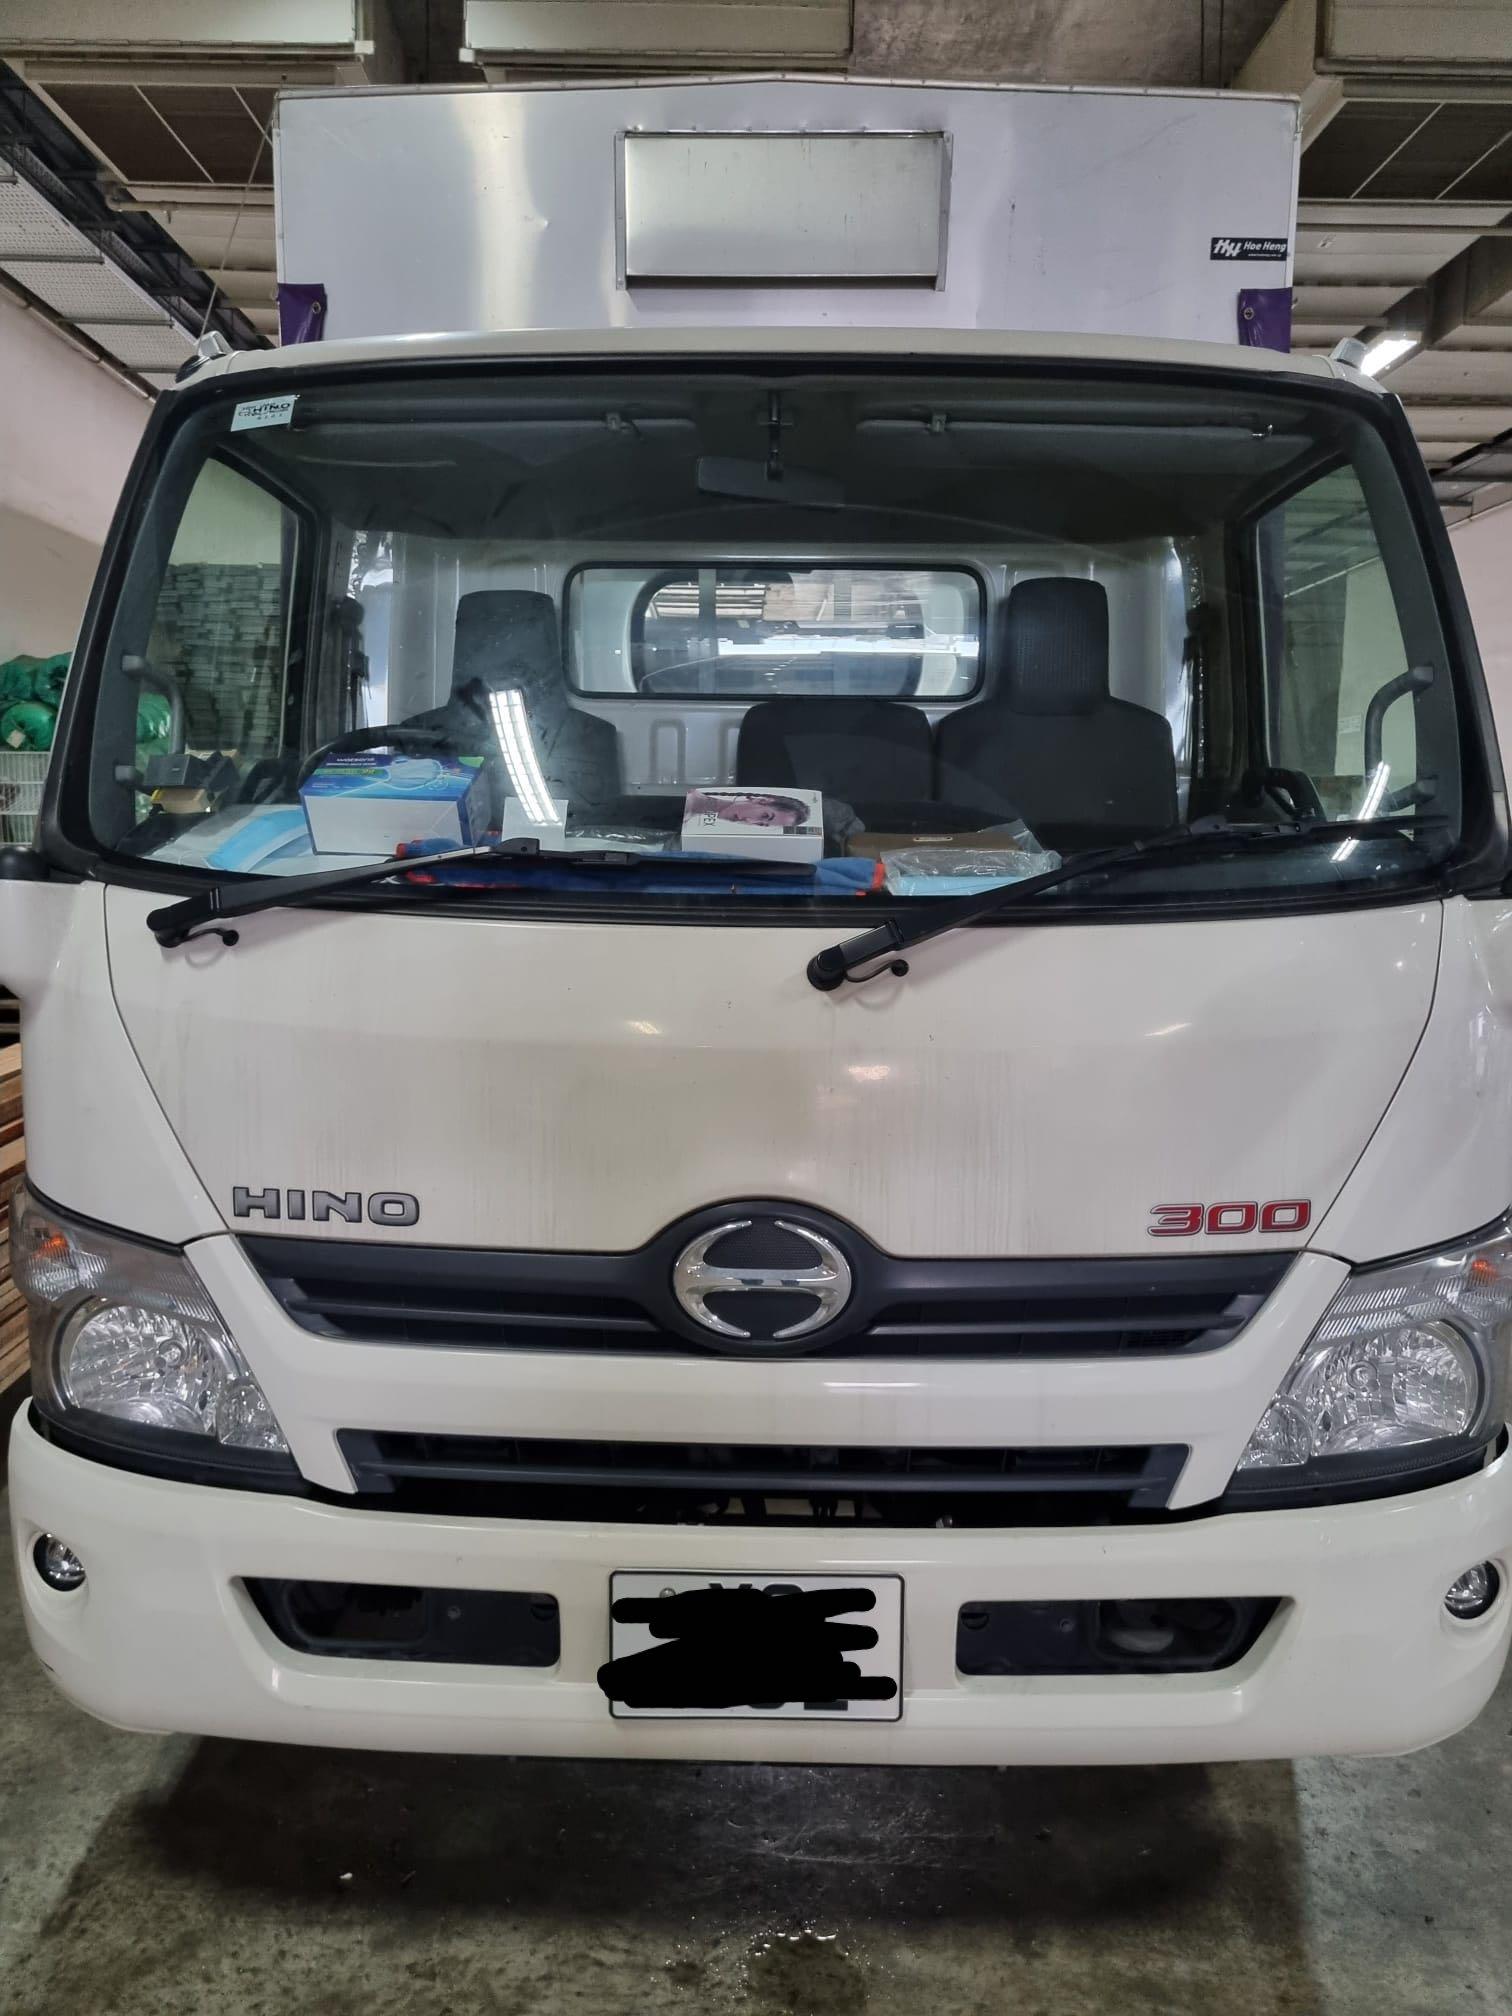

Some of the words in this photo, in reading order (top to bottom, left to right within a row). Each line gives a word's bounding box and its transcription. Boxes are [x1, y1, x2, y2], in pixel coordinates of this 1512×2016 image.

[1243, 242, 1261, 251] Hoe
[1262, 242, 1287, 252] Heng
[233, 1187, 419, 1227] HINO
[1148, 1199, 1311, 1236] 300
